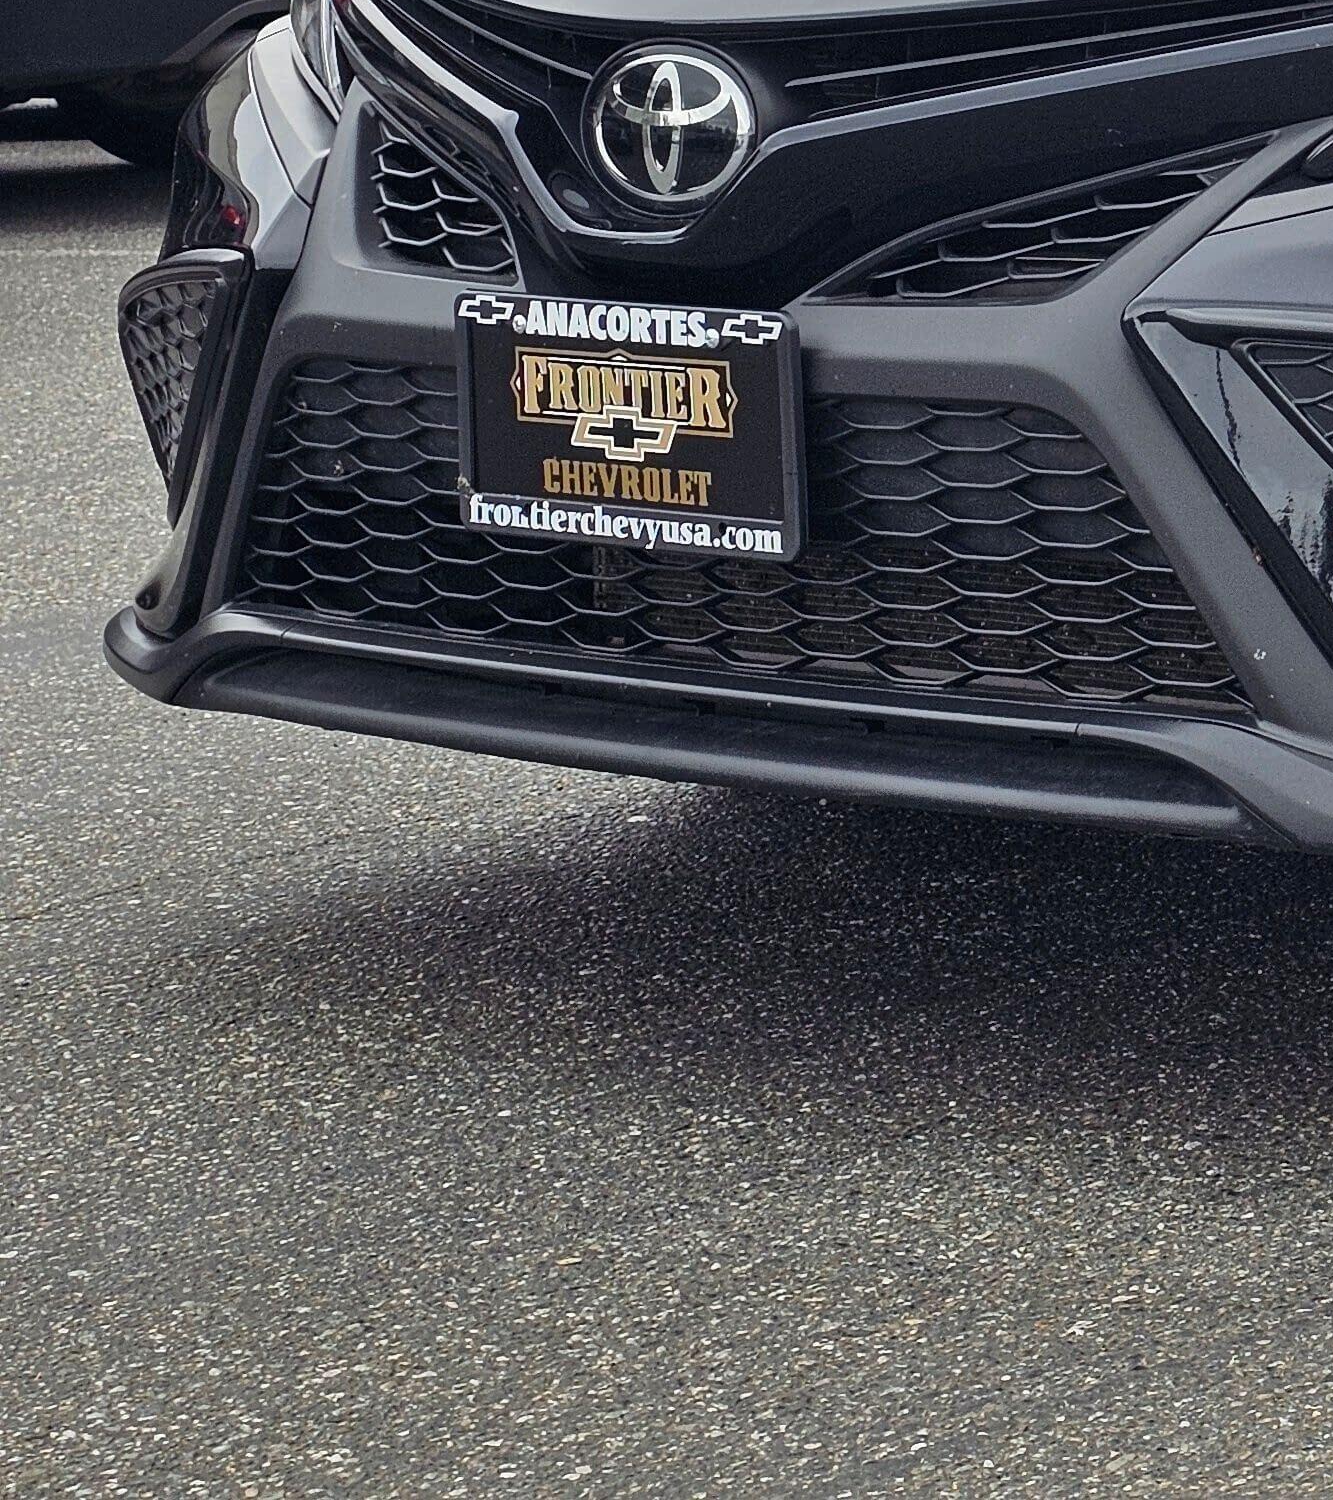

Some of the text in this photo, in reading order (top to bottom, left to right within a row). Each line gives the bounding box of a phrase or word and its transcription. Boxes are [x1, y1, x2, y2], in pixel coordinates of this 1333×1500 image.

[525, 301, 708, 347] ANACORTES
[522, 355, 726, 428] FRONTIER
[543, 457, 712, 506] CHEVROLET
[468, 494, 784, 553] frontierchevyusa.com
